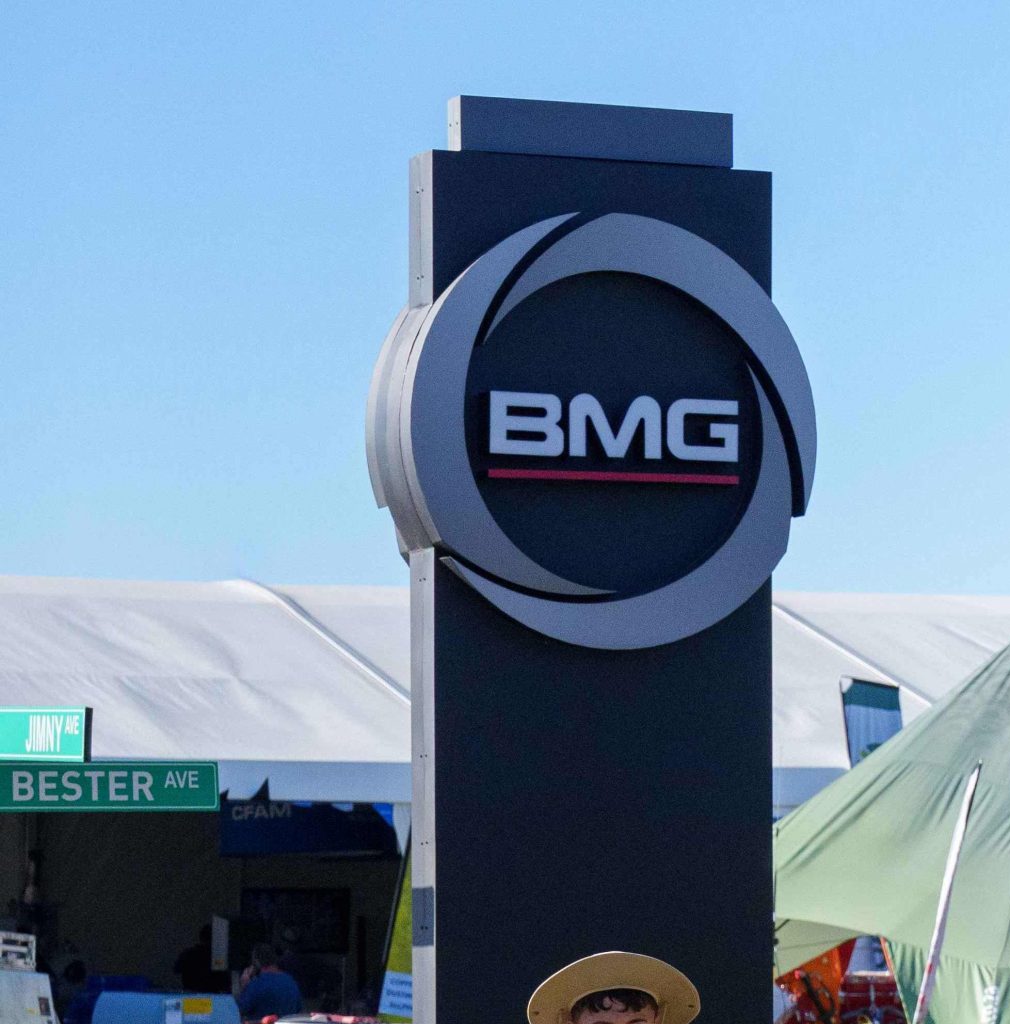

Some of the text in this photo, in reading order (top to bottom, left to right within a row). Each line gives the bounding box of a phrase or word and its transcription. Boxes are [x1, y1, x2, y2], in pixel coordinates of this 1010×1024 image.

[489, 390, 740, 463] BMG
[25, 715, 80, 753] JIMNY AVE
[12, 770, 200, 802] BESTER AVE
